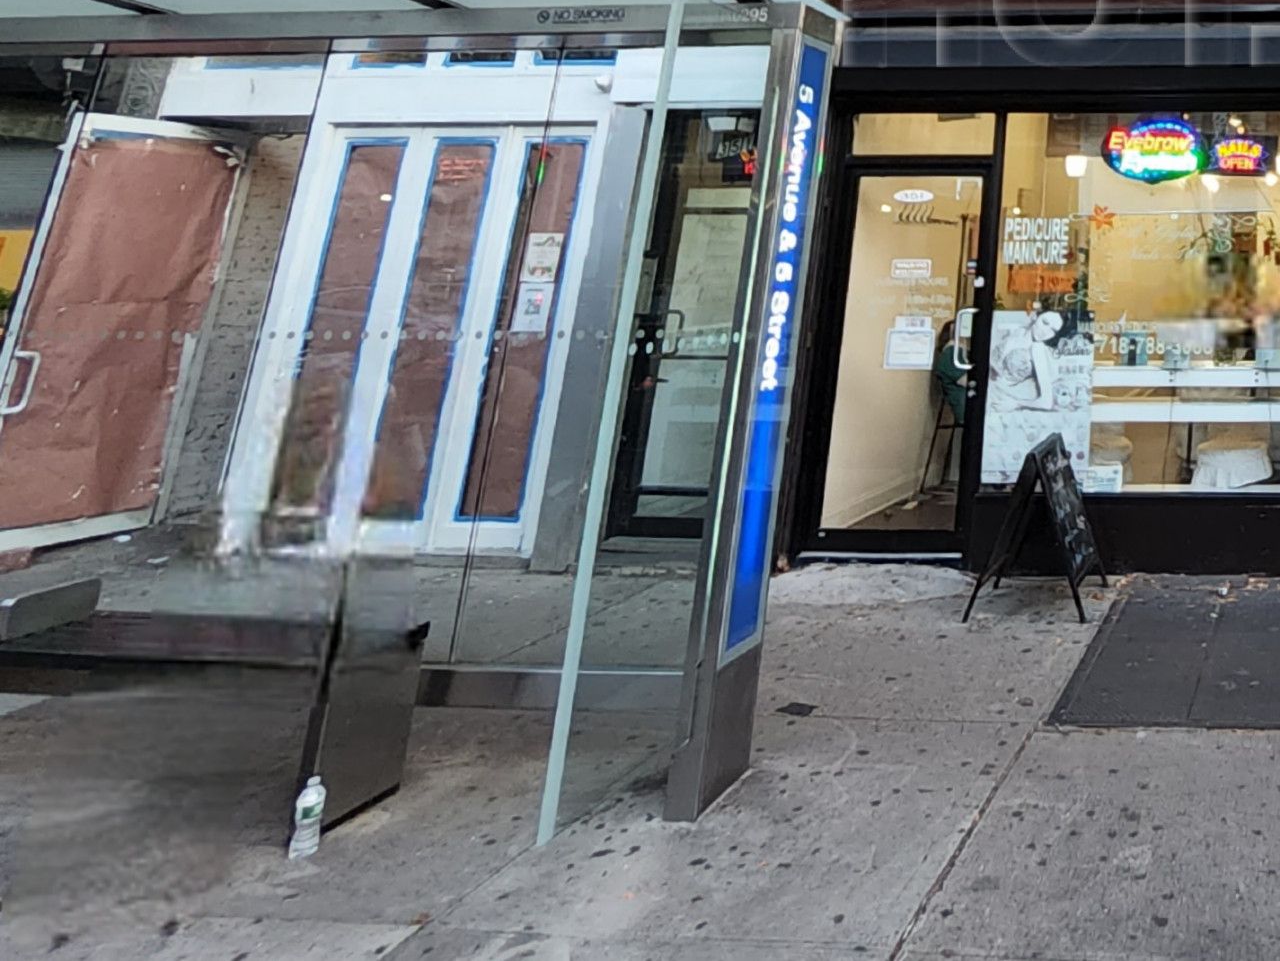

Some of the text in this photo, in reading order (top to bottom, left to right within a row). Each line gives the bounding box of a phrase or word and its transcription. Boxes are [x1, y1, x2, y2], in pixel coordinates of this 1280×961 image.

[552, 8, 625, 21] NO SMOKING
[799, 84, 814, 104] 5
[1108, 130, 1192, 152] Eyebrow
[783, 109, 812, 223] Avenue
[1219, 156, 1256, 170] OPEN
[778, 229, 797, 253] &
[1004, 217, 1070, 241] PEDICURE
[1003, 241, 1068, 265] MANICURE
[760, 290, 790, 392] Street
